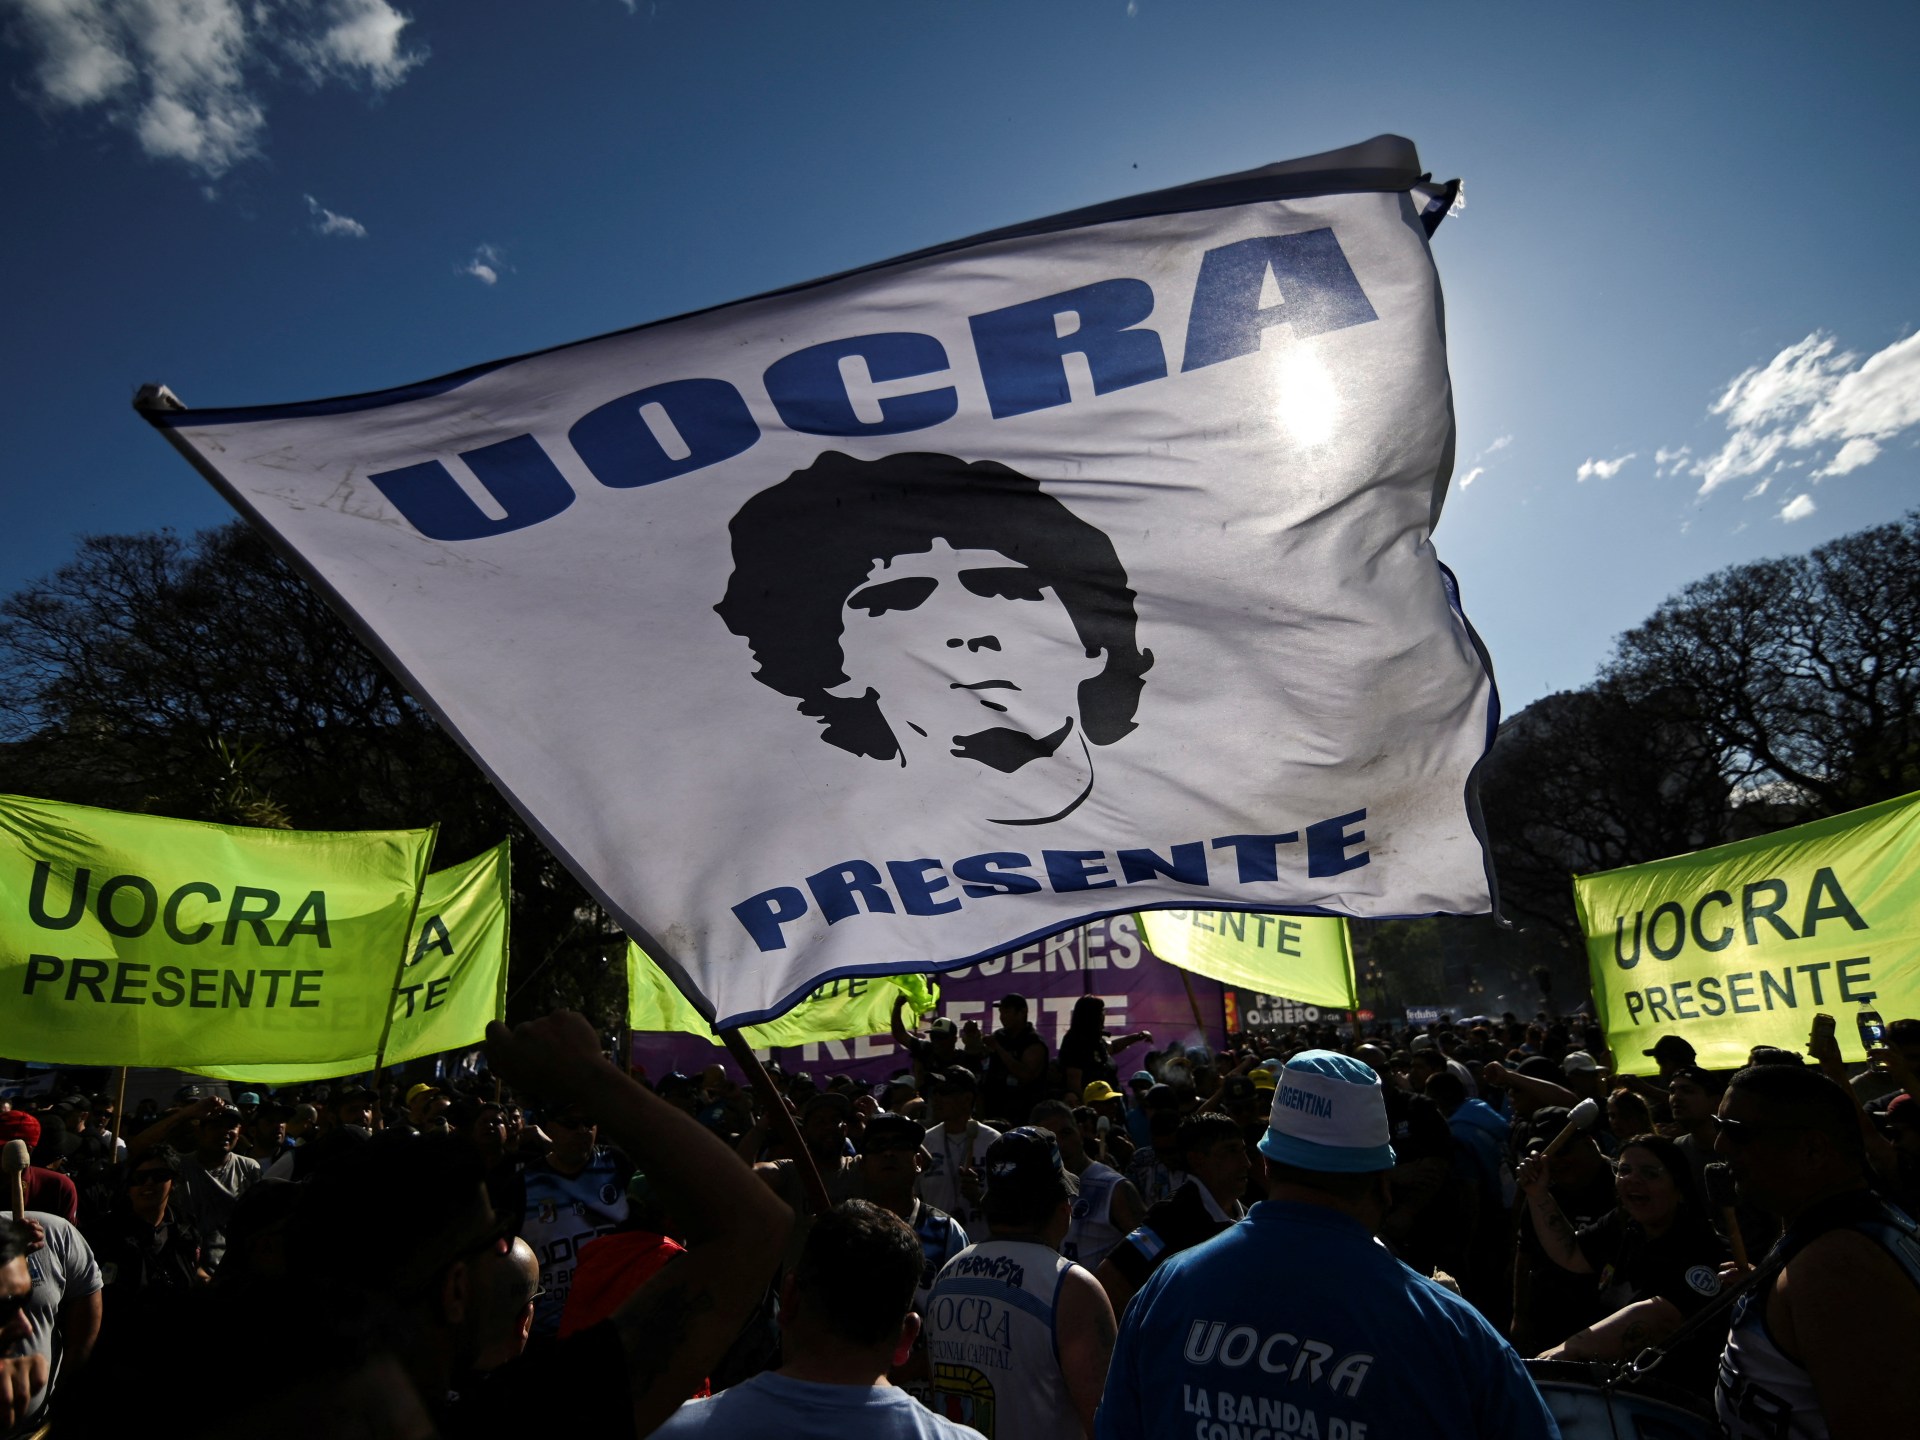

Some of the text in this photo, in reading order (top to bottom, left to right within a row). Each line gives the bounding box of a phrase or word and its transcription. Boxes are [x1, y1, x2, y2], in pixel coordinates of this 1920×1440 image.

[368, 227, 1378, 541] UOCRA
[28, 861, 331, 949] UOCRA
[731, 808, 1370, 952] PRESENTE
[1615, 867, 1869, 969] UOCRA
[22, 954, 324, 1009] PRESENTE
[1625, 956, 1877, 1025] PRESENTE
[1184, 1319, 1377, 1400] UOCRA
[1183, 1383, 1368, 1440] LA BANDA DE
